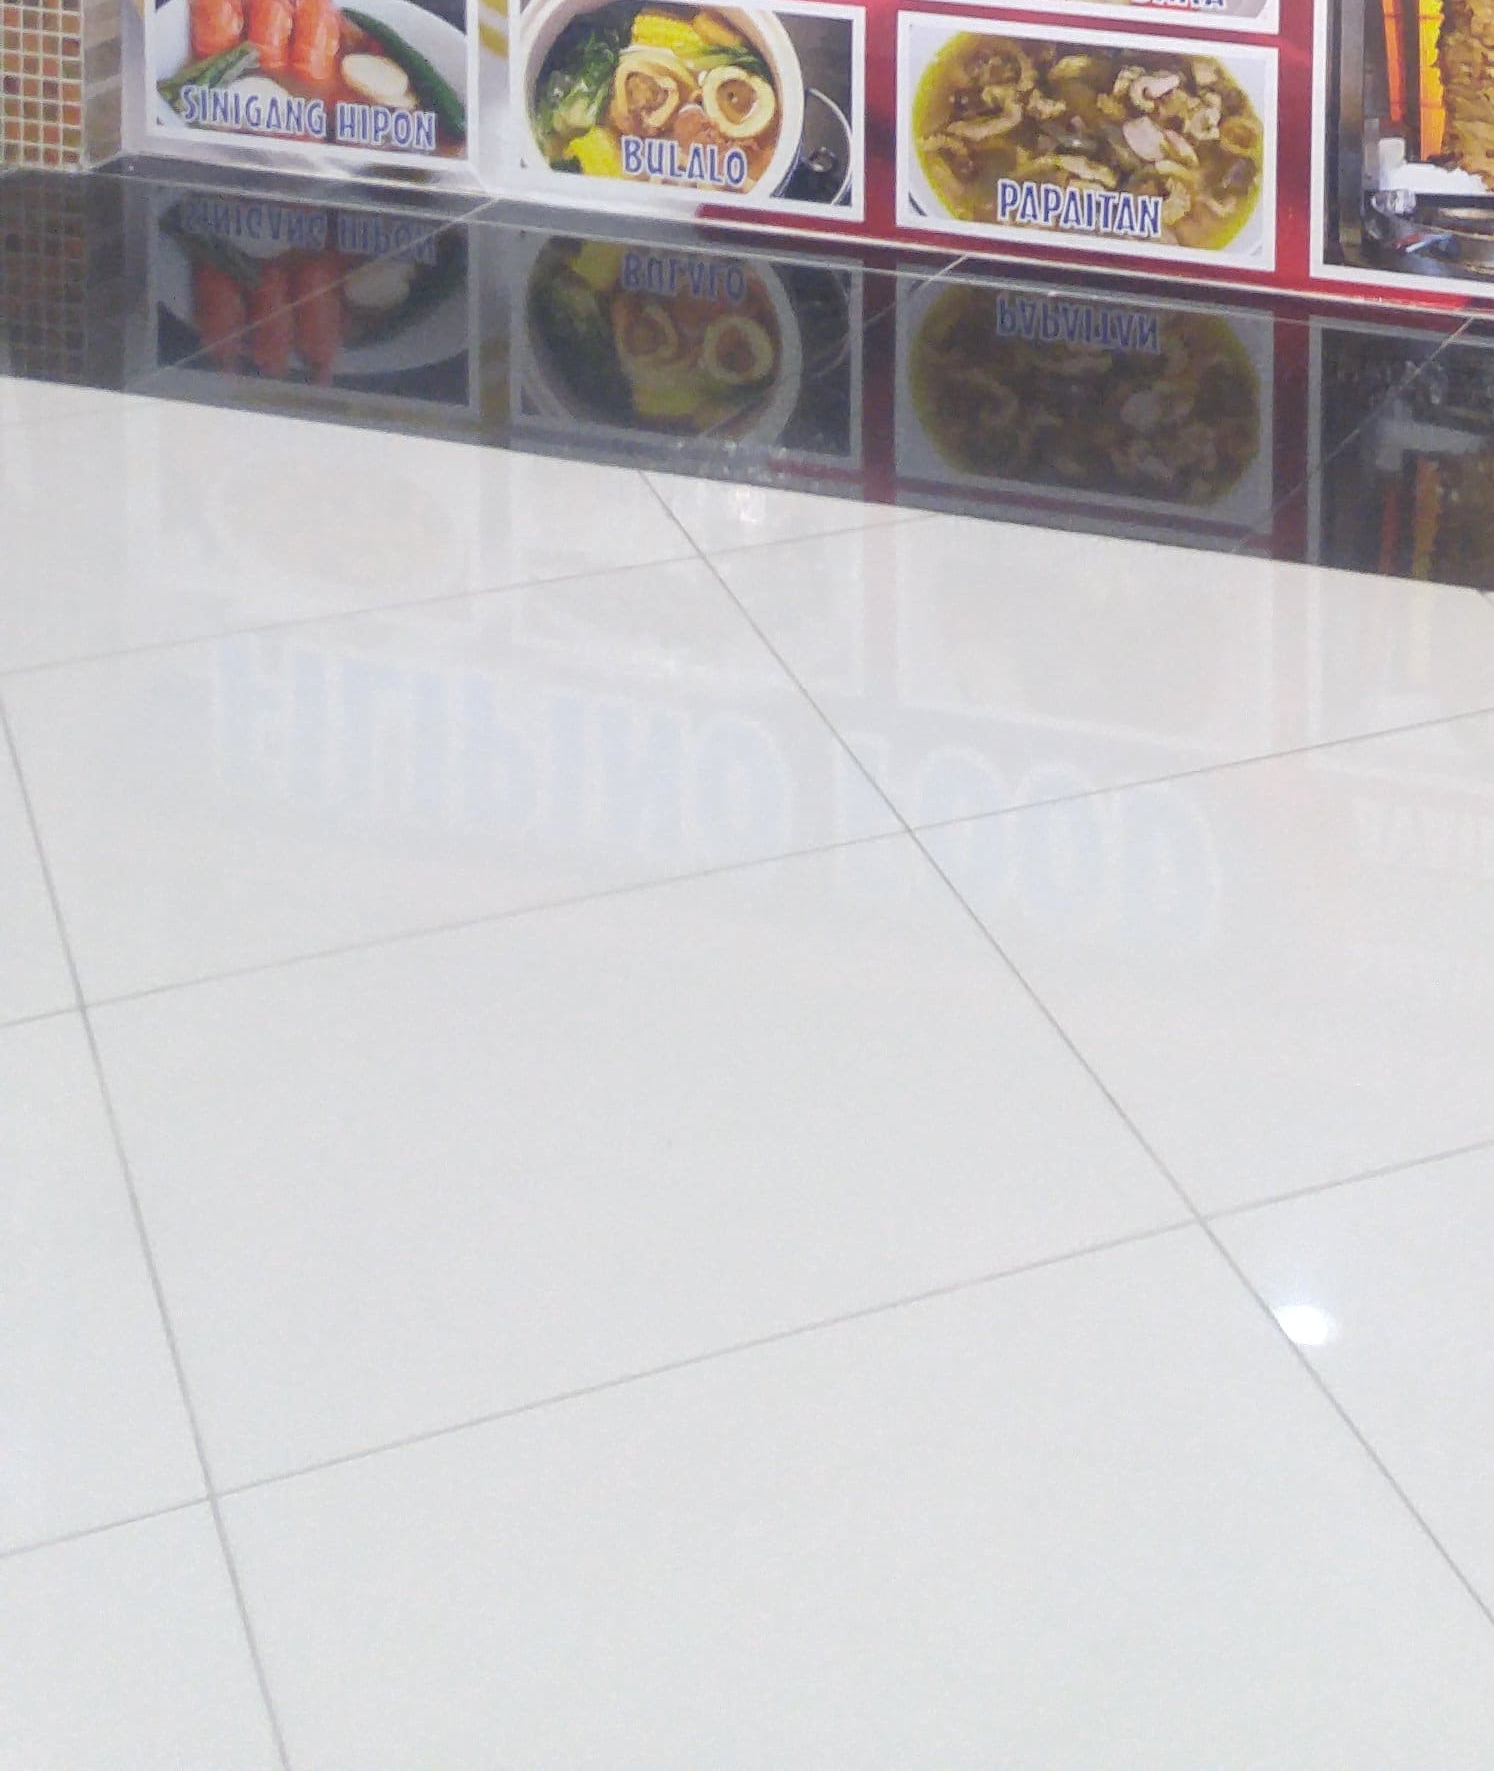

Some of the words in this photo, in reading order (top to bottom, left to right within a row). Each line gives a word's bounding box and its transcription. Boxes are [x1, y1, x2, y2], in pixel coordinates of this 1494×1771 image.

[181, 85, 327, 140] SINIGANG
[336, 109, 437, 151] HIPON
[620, 135, 750, 189] BULALO
[998, 178, 1164, 239] PAPAITAN
